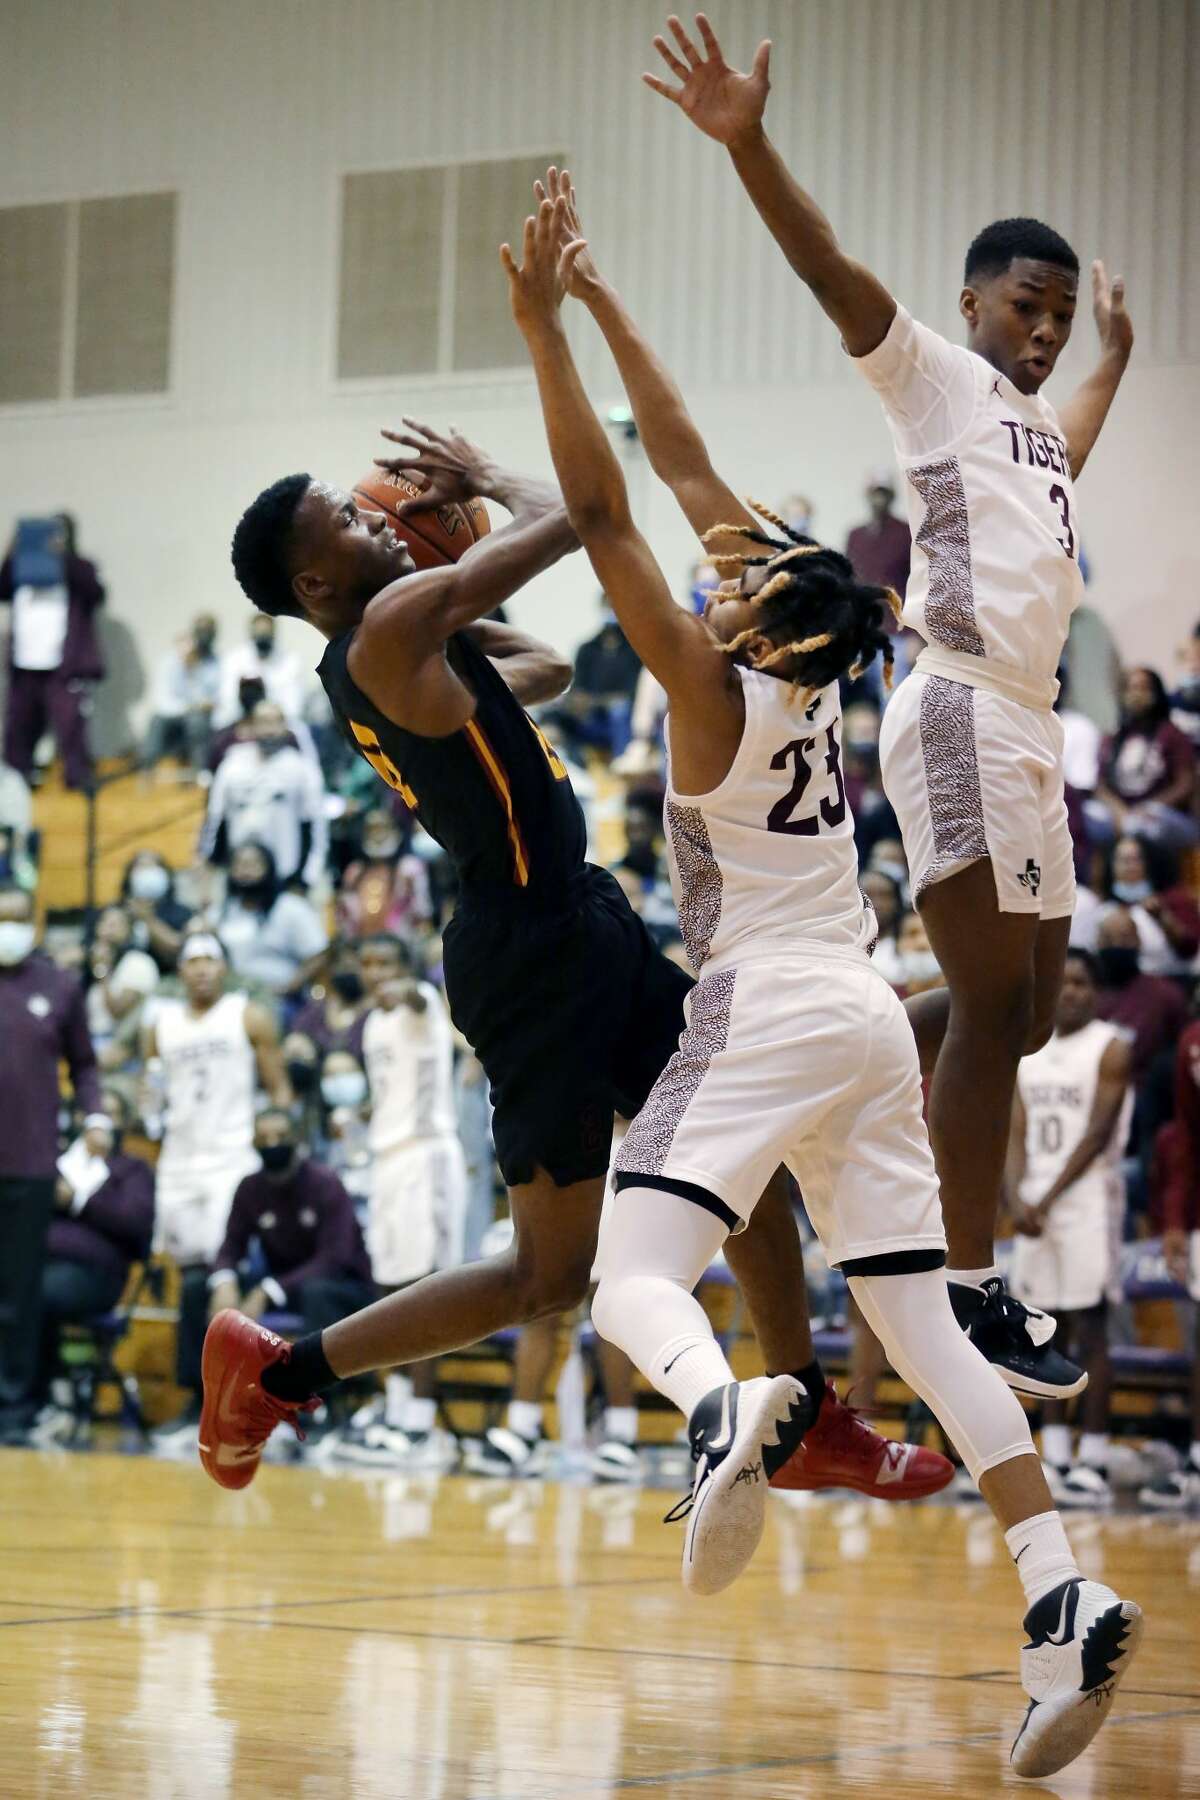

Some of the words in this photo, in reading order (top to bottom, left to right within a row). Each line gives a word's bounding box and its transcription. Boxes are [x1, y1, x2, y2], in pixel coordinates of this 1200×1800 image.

[999, 420, 1071, 477] TIGER
[1049, 483, 1074, 559] 3
[767, 716, 846, 836] 23
